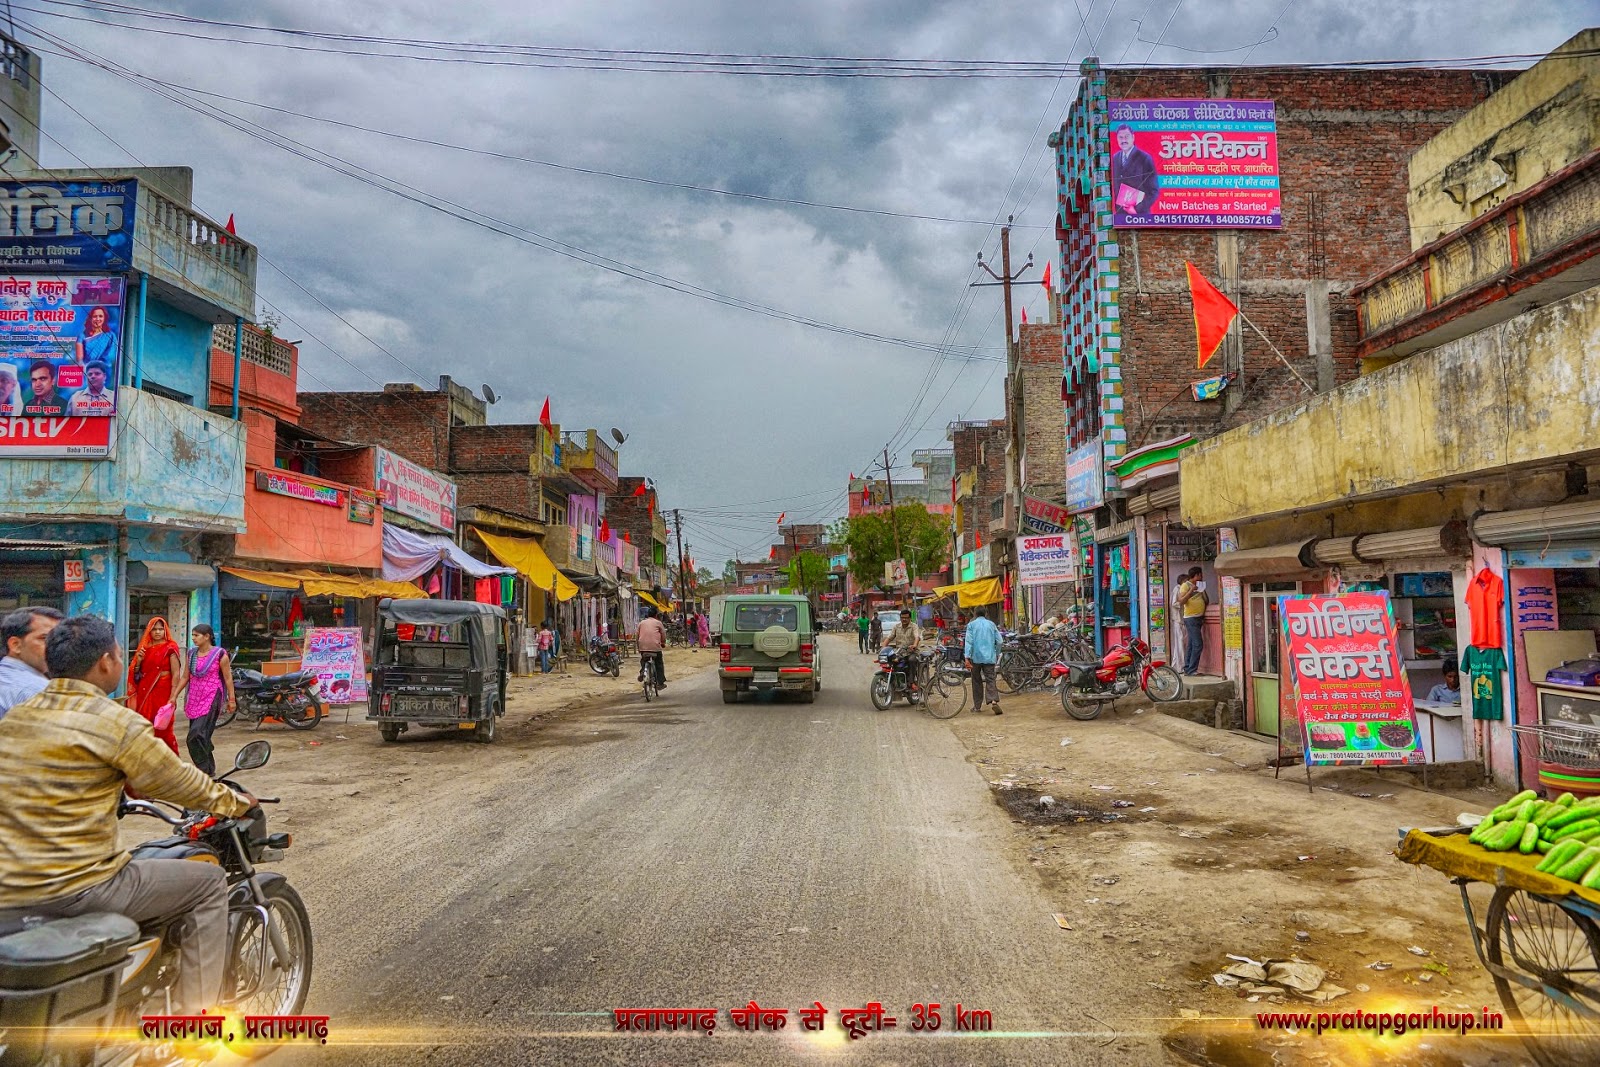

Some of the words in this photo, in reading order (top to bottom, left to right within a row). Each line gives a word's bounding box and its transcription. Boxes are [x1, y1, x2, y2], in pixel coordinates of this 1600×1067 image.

[1112, 103, 1150, 120] अंग्रेजी
[1152, 104, 1190, 120] बोलना
[1193, 103, 1236, 120] सीखिये
[1236, 108, 1247, 119] 90
[1248, 109, 1266, 120] दिनों
[1267, 109, 1275, 119] में
[1159, 132, 1268, 159] अमेरिकन
[1163, 161, 1205, 173] मनोवैज्ञानिक
[1207, 161, 1228, 174] पद्धति
[1231, 164, 1241, 173] पर
[1244, 162, 1274, 173] आधारित
[83, 185, 100, 194] Reg.
[101, 184, 126, 193] 51476
[1182, 176, 1201, 186] बोलना
[1225, 178, 1233, 186] पर
[1234, 176, 1244, 188] पूरी
[1159, 201, 1179, 210] New
[1181, 201, 1219, 210] Batches
[1234, 201, 1267, 211] Started
[1125, 215, 1152, 224] Con.-
[1154, 215, 1214, 225] 9415170874,
[1216, 216, 1273, 225] 8400857216
[26, 245, 43, 256] रोग
[37, 281, 68, 301] स्कूल
[0, 310, 28, 321] घाटन
[34, 307, 75, 321] समारोह
[287, 480, 316, 499] welcome
[1023, 496, 1069, 526] सागर
[1024, 537, 1064, 549] आजाद
[1020, 549, 1050, 562] मेडिकल
[1051, 548, 1070, 559] स्टोर
[66, 561, 82, 578] 3G
[1289, 600, 1386, 638] गोविन्द
[310, 632, 346, 647] रवि
[306, 648, 352, 664] स्वीट्स
[1296, 638, 1393, 679] बेकर्स
[1331, 690, 1348, 700] केक
[1351, 692, 1358, 700] व
[1360, 690, 1382, 701] पेस्ट्री
[1386, 690, 1403, 698] केक
[400, 697, 428, 711] अंकित
[432, 697, 451, 711] सिंह
[1324, 712, 1339, 720] वेज
[1341, 712, 1358, 720] केक
[1361, 711, 1390, 720] उपलब्ध
[1313, 752, 1329, 760] Mob:
